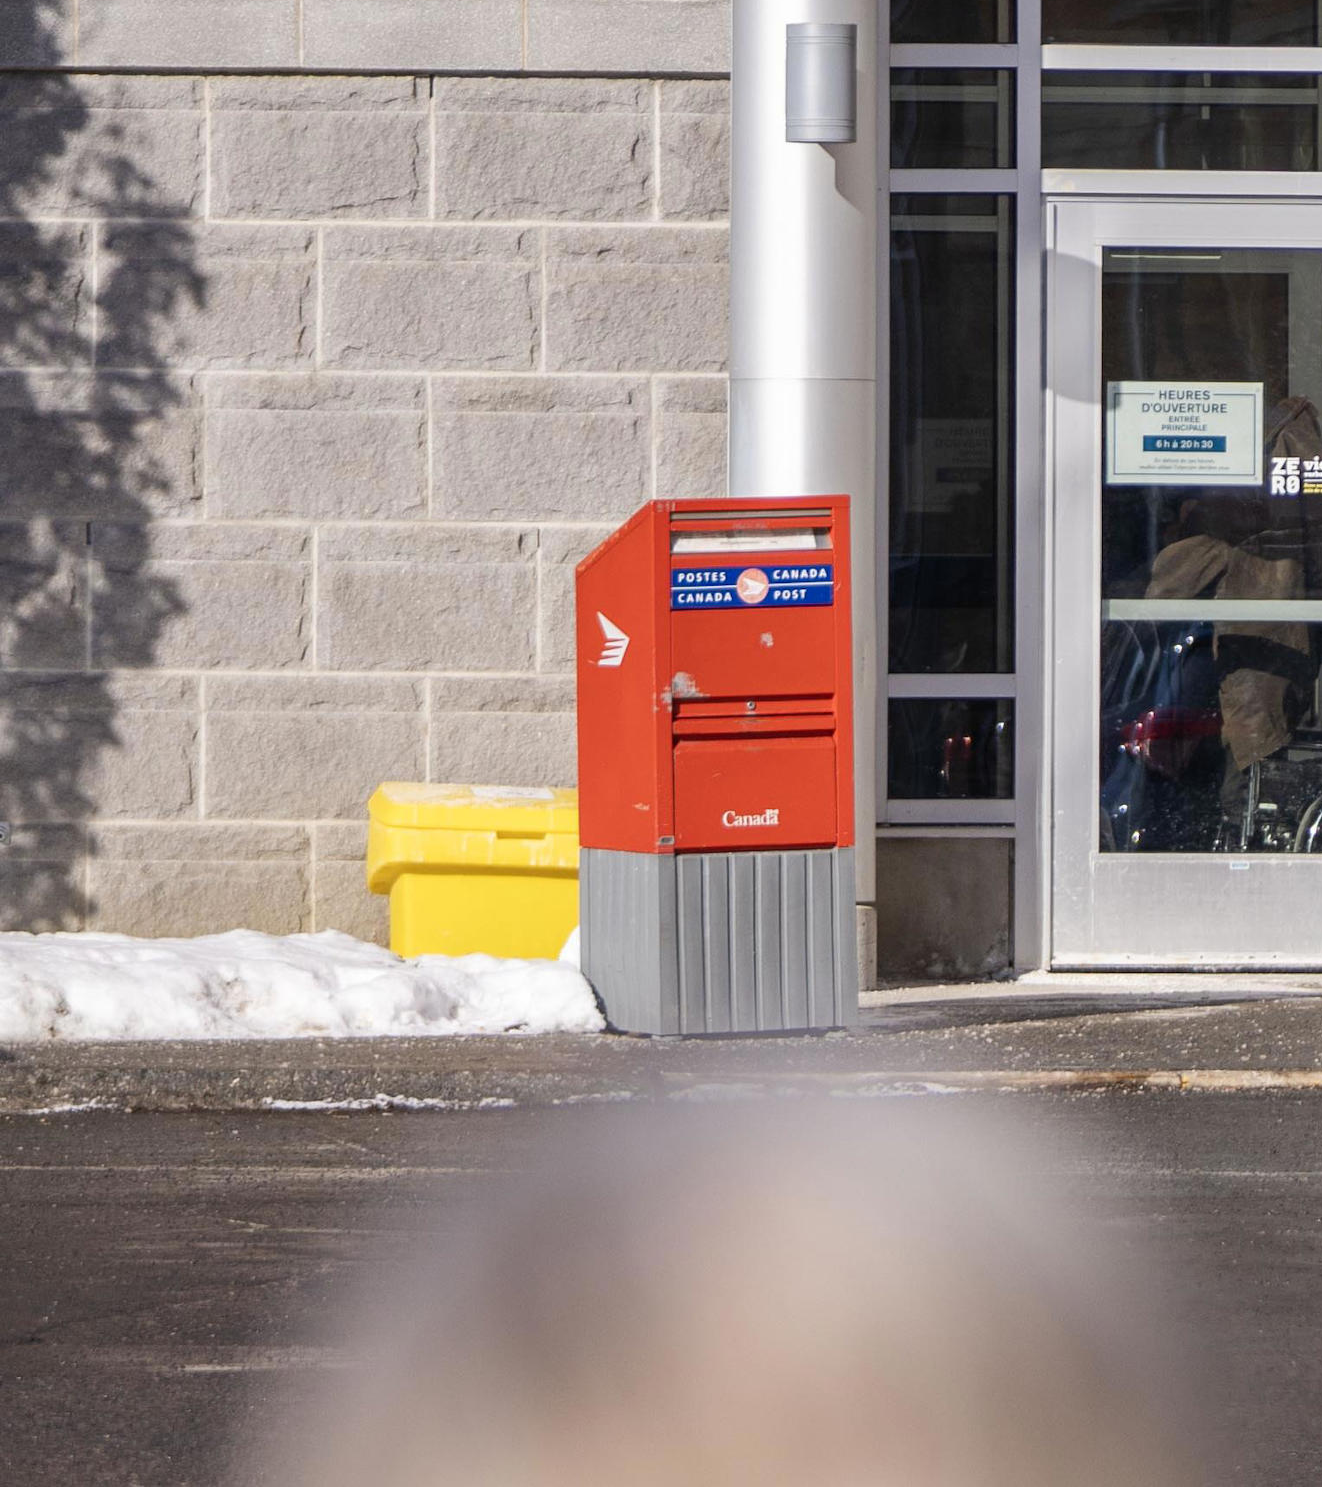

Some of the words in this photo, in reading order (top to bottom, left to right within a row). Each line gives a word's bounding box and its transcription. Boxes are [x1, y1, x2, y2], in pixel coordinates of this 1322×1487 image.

[1158, 390, 1211, 400] HEURES
[1141, 402, 1228, 414] D'OUVERTURE
[1161, 424, 1208, 432] PRINCIPALE
[1155, 440, 1163, 449] 6
[1163, 440, 1171, 449] h
[1180, 440, 1193, 449] 20
[1193, 440, 1200, 449] h
[1201, 440, 1214, 449] 30
[677, 571, 727, 583] POSTES
[773, 568, 828, 580] CANADA
[677, 592, 733, 604] CANADA
[773, 589, 807, 601] POST
[722, 809, 779, 827] Canada
